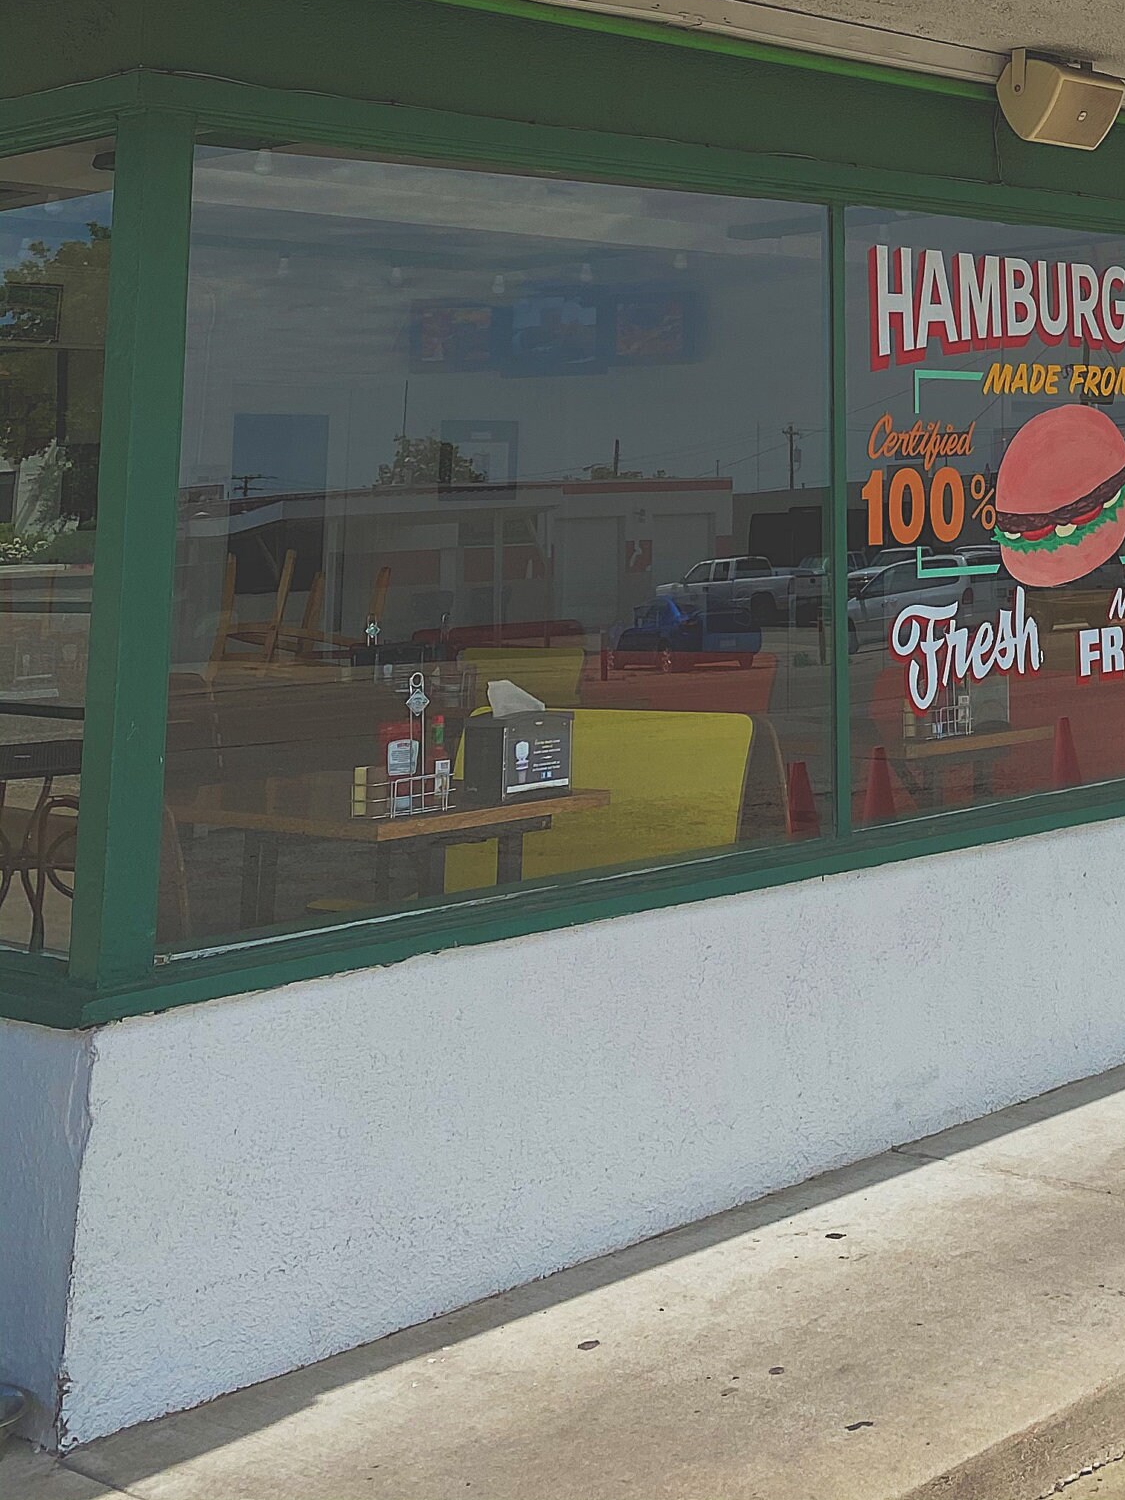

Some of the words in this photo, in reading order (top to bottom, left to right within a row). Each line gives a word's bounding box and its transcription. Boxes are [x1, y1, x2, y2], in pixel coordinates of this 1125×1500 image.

[982, 363, 1062, 396] MADE
[868, 412, 976, 471] Certified
[862, 466, 997, 545] 100%
[892, 586, 1042, 712] Fresh
